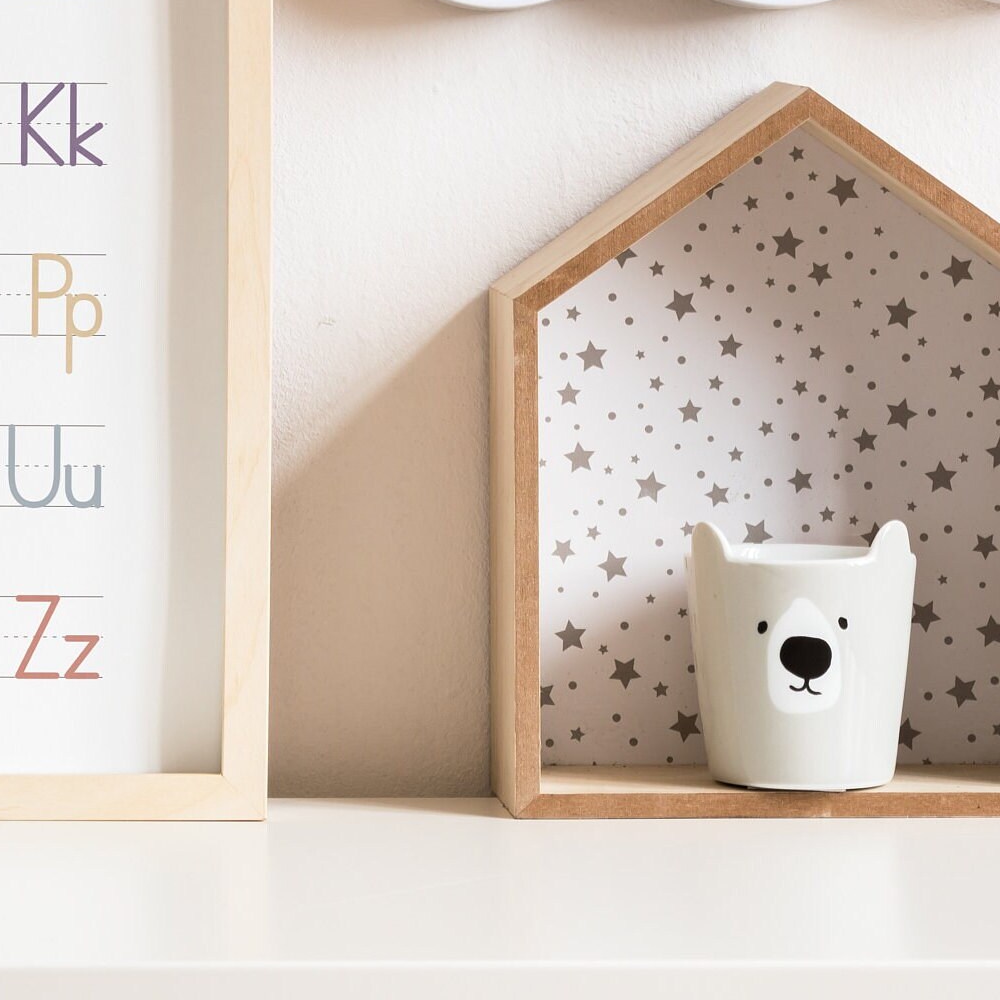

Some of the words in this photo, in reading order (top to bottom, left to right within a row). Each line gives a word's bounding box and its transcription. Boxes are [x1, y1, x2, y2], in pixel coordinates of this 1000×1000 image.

[21, 82, 103, 166] Kk
[31, 253, 102, 374] Pp
[8, 425, 101, 508] Uu
[15, 595, 100, 679] Zz
